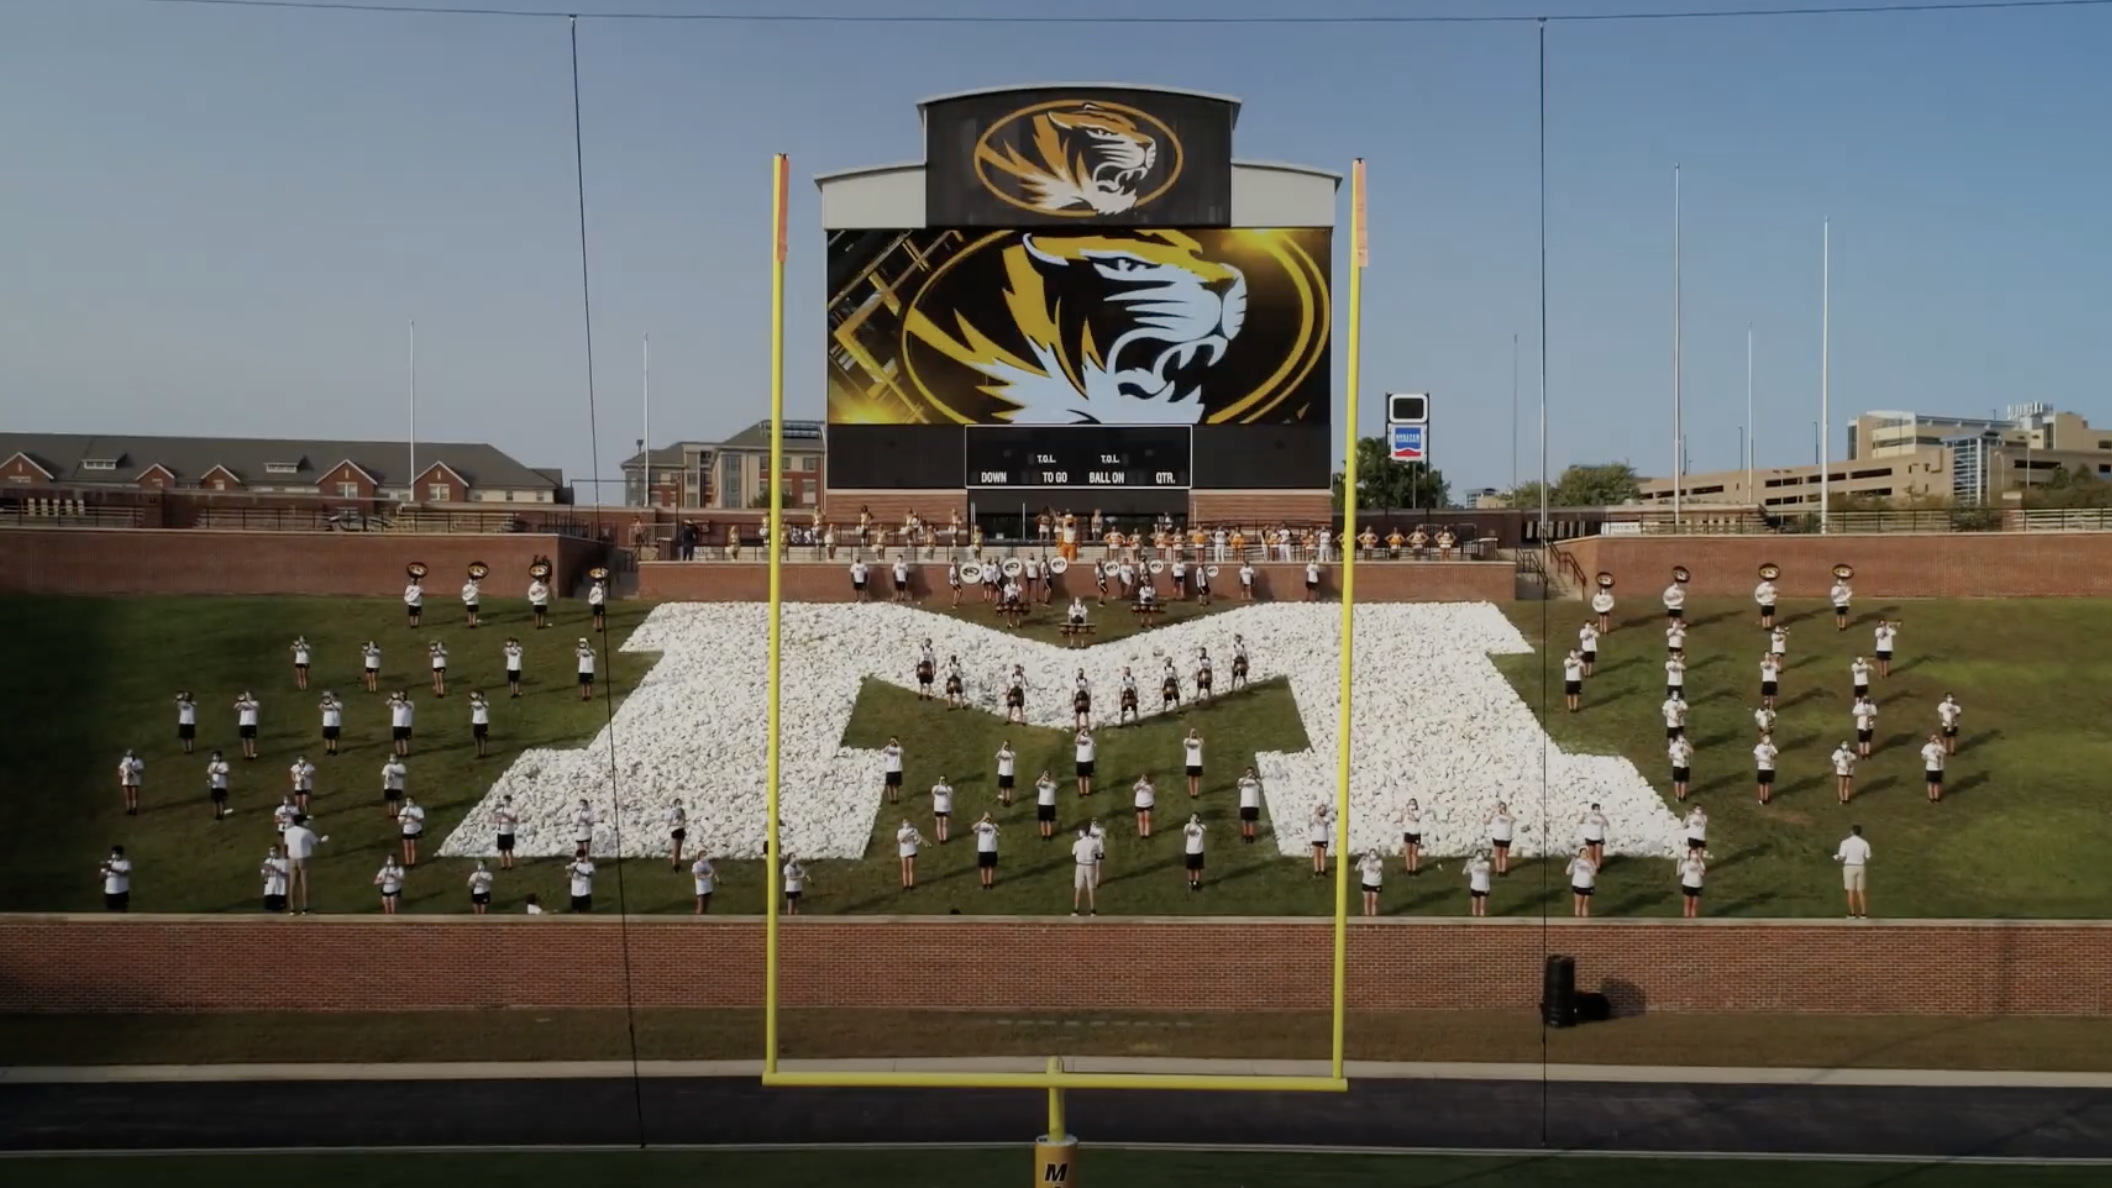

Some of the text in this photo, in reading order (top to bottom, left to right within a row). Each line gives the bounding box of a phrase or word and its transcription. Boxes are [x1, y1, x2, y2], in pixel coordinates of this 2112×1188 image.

[981, 471, 1007, 483] DOWN
[1042, 471, 1068, 483] TO GO
[1089, 471, 1125, 484] BALL ON
[1156, 471, 1176, 484] QTR.
[436, 599, 1691, 862] M
